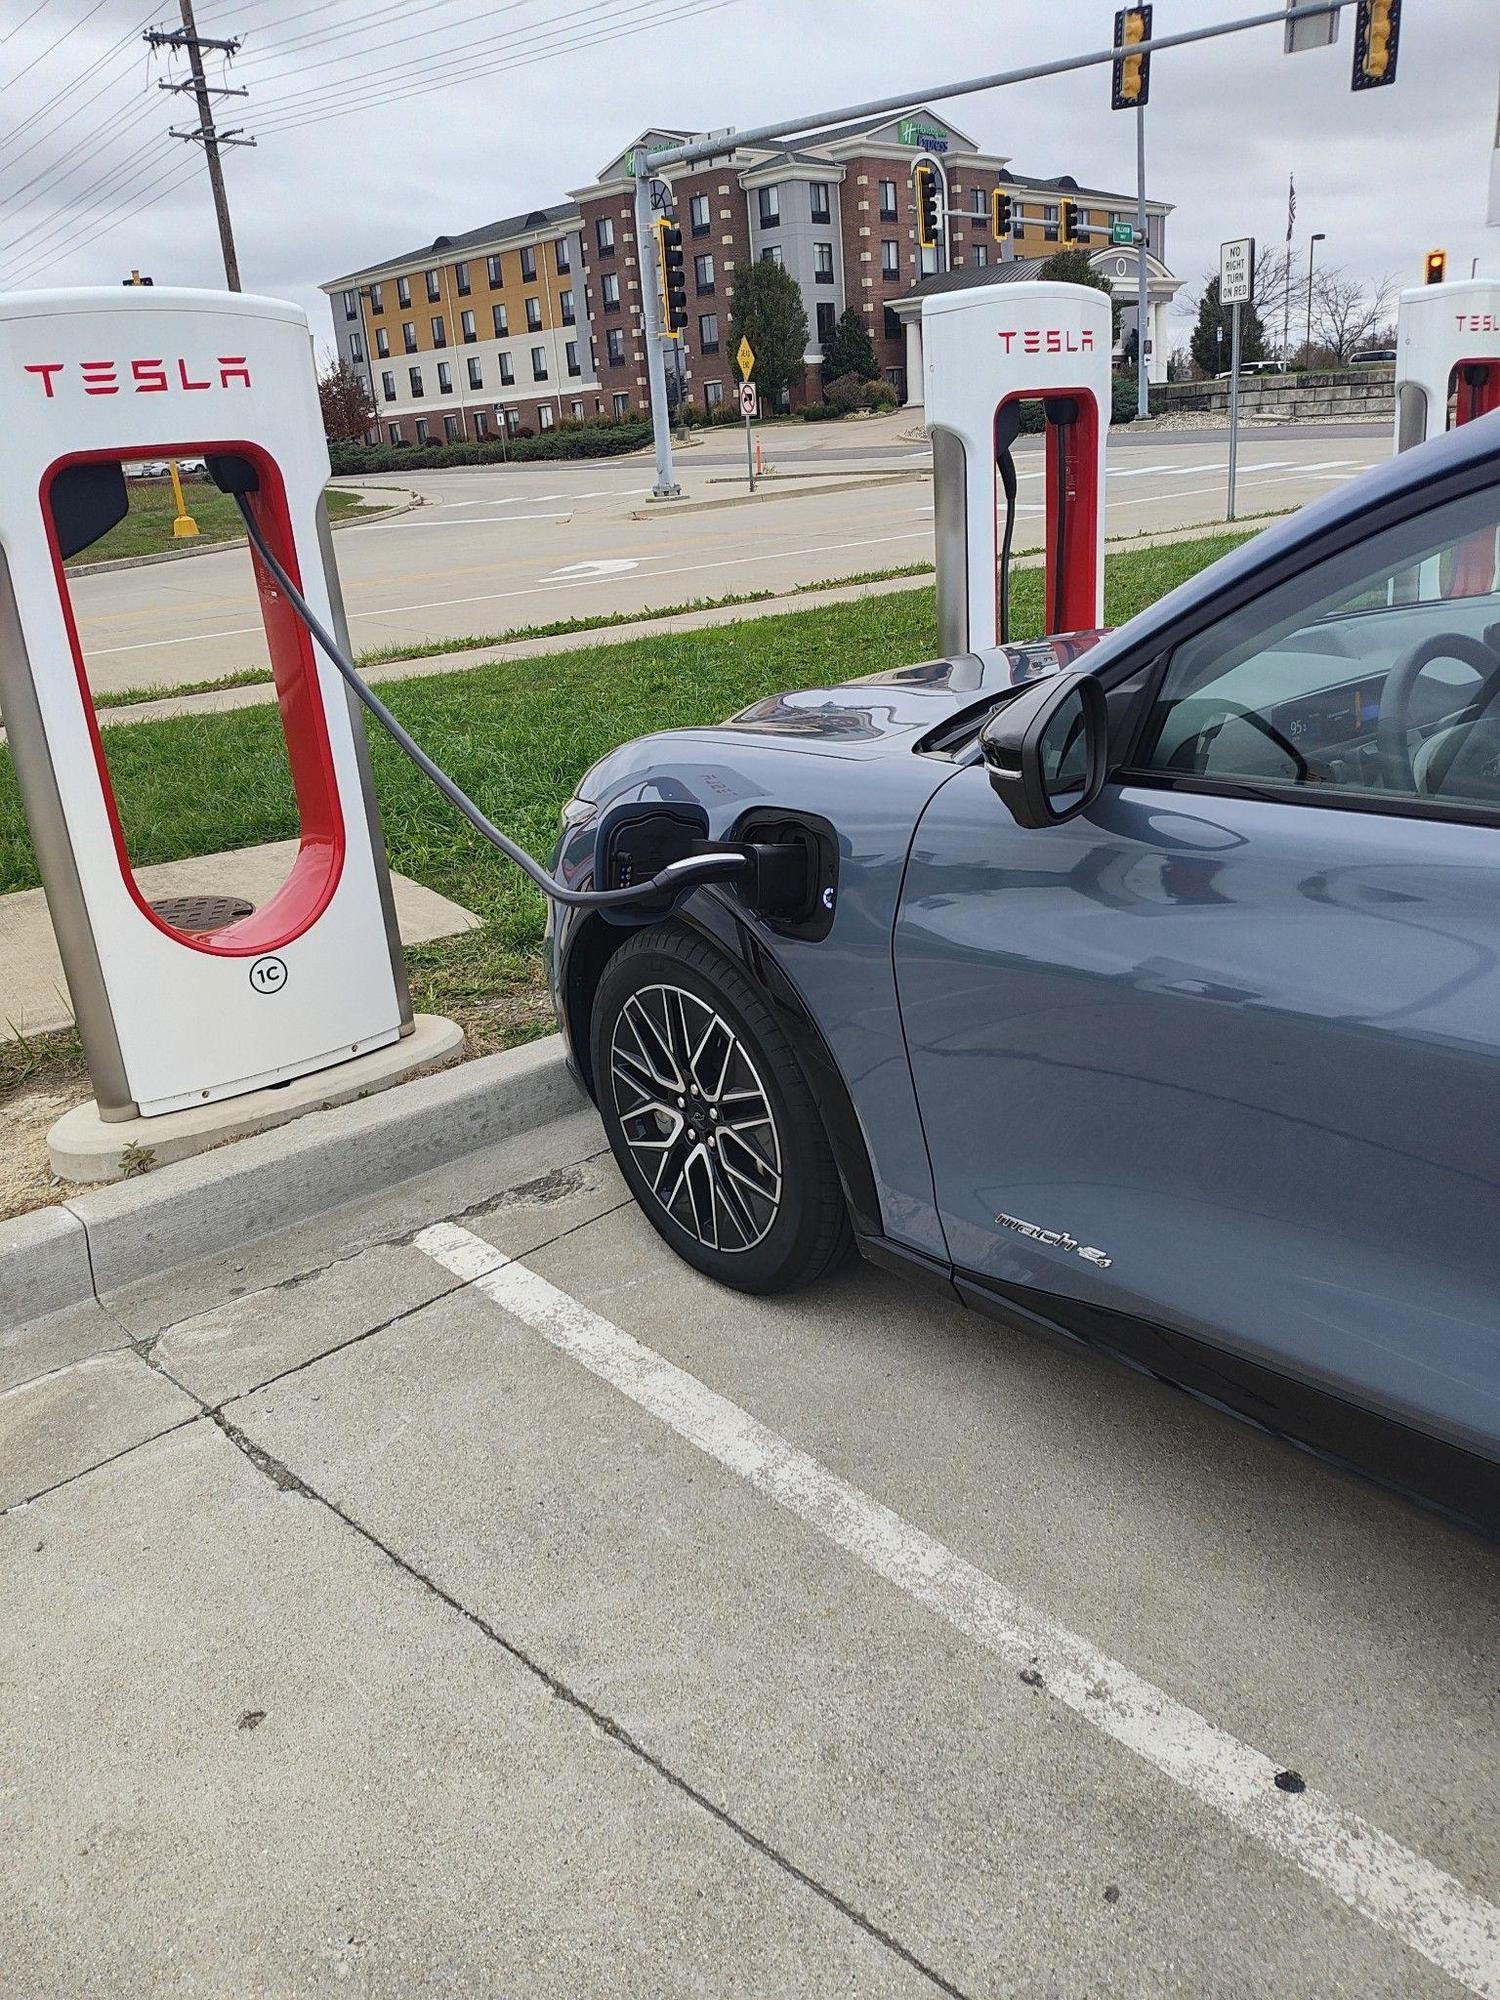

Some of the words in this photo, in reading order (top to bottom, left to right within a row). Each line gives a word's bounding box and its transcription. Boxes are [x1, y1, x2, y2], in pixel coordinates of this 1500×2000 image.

[1230, 246, 1240, 257] NO
[1225, 259, 1244, 271] RIGHT
[1227, 272, 1243, 284] TURN
[1223, 287, 1232, 298] ON
[1234, 284, 1247, 297] RED
[998, 330, 1093, 354] TESLA
[24, 356, 251, 398] TESLA
[256, 966, 280, 984] 1C
